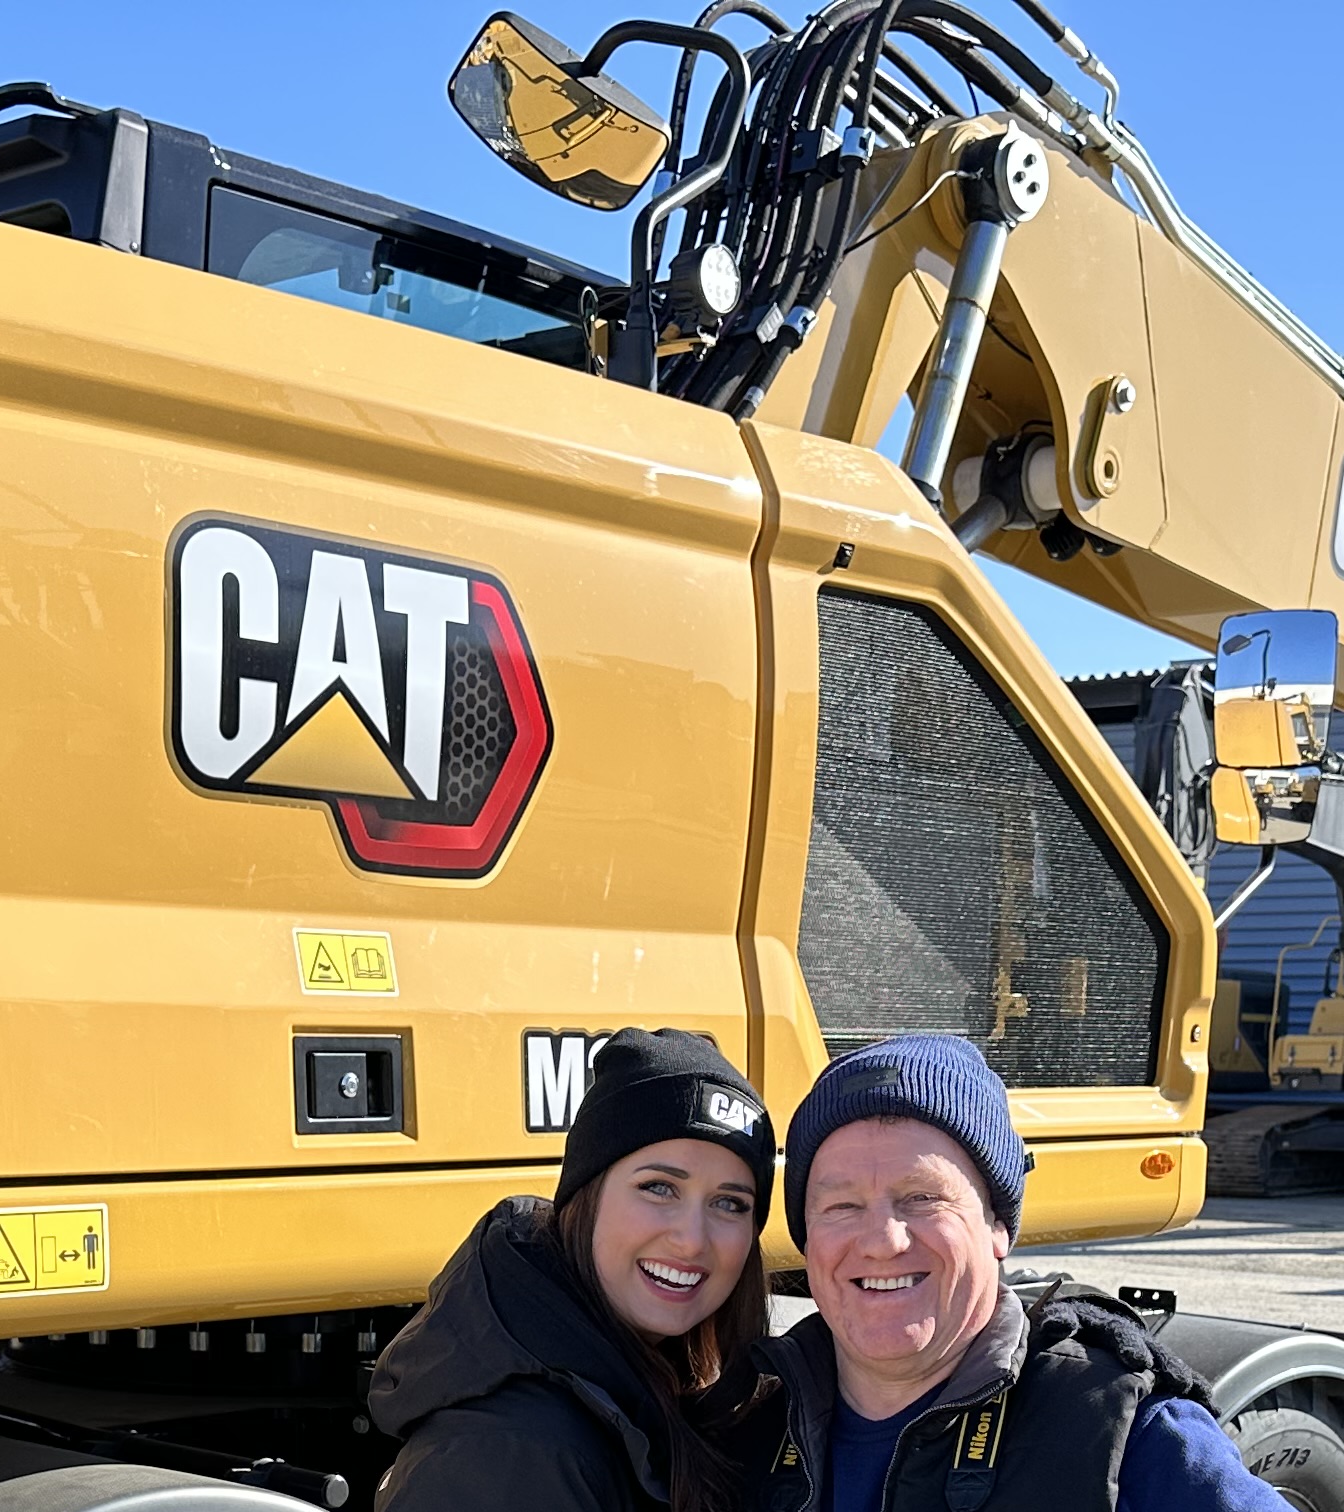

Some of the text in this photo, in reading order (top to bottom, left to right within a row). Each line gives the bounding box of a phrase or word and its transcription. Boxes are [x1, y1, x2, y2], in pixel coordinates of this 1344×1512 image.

[180, 527, 469, 801] CAT
[709, 1092, 759, 1138] CAT
[967, 1411, 993, 1460] Nikon
[1275, 1447, 1312, 1468] 713
